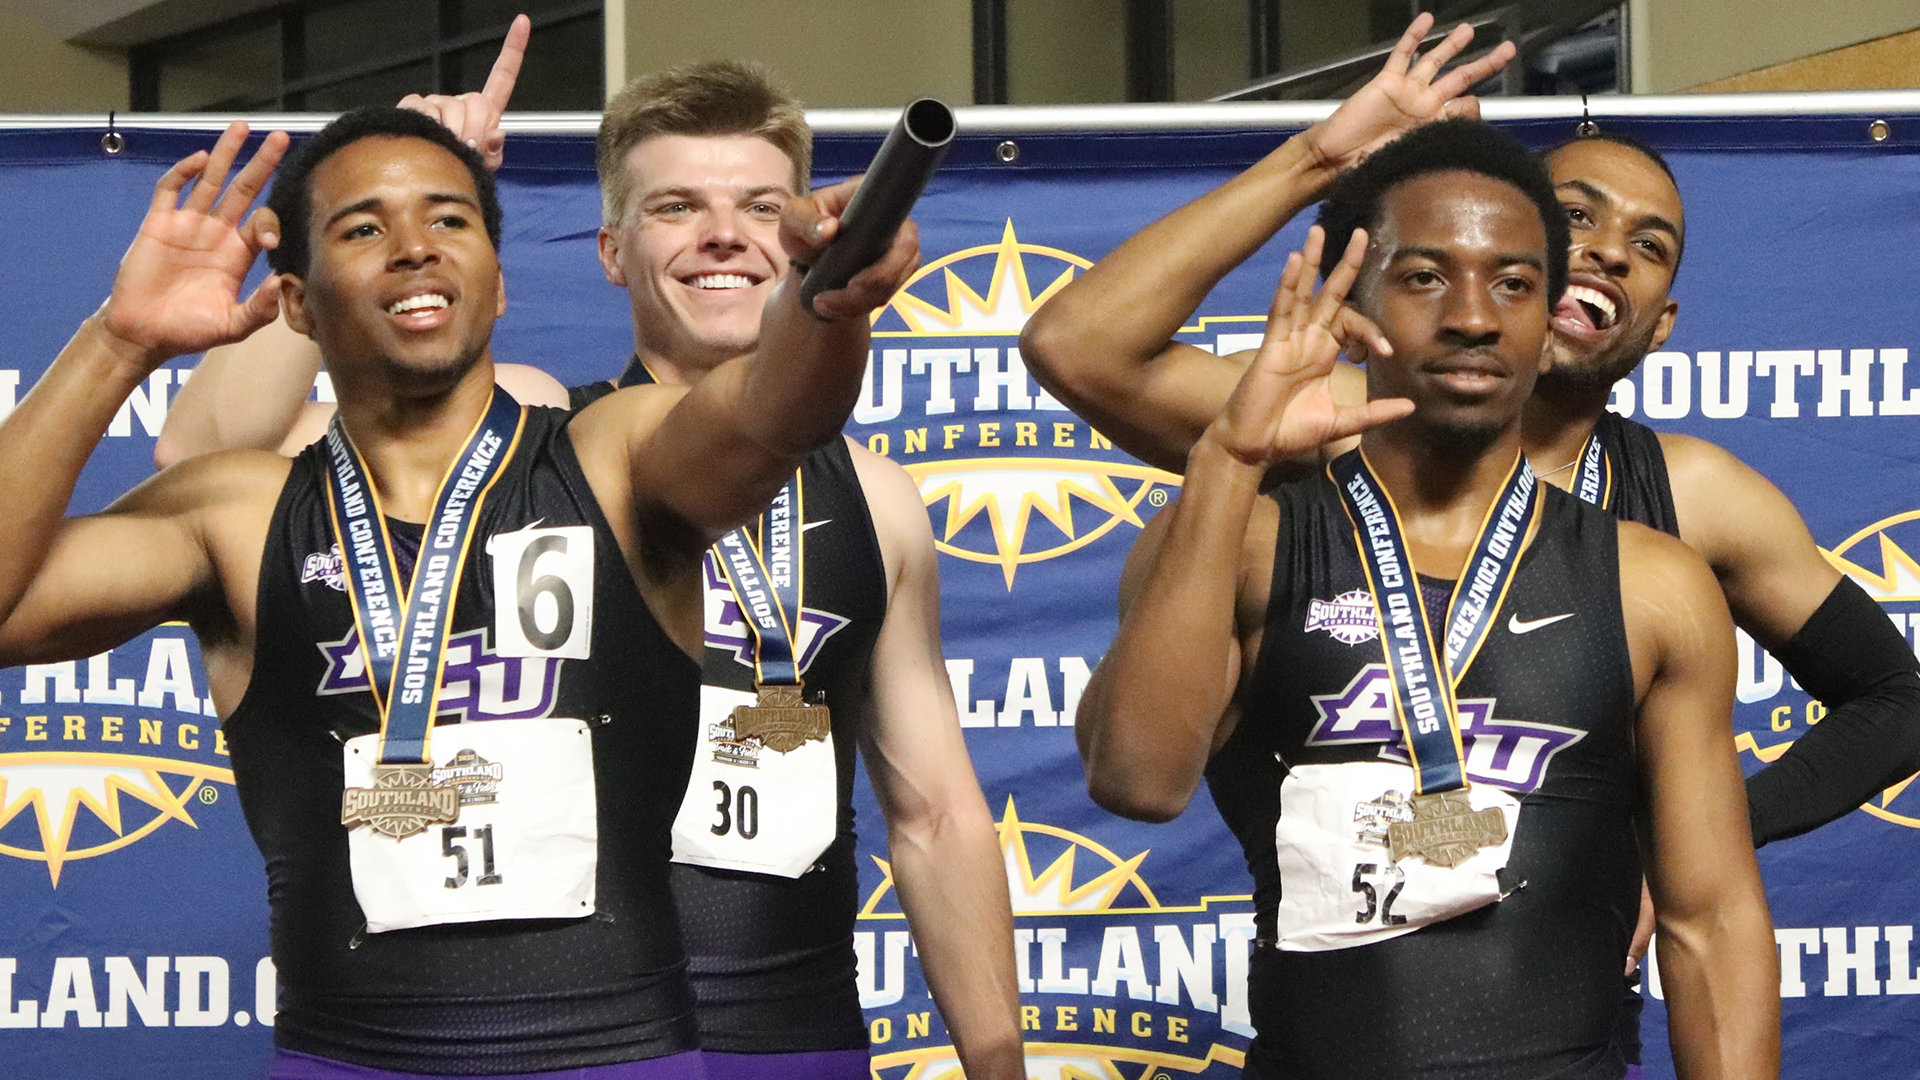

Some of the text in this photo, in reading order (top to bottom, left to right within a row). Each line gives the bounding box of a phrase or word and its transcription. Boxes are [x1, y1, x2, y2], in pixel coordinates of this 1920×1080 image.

[1580, 435, 1601, 505] ERENCE
[348, 518, 399, 658] CONFERENCE
[401, 428, 503, 704] SOUTHLAND CONFERENCE
[517, 535, 574, 650] 6
[1346, 472, 1440, 735] SOUTHLAND CONFERENCE
[1445, 555, 1501, 668] CONFEREN
[345, 789, 456, 818] SOUTHLAND
[432, 763, 501, 787] SOUTHLAND
[710, 780, 758, 840] 30
[442, 823, 502, 889] 51
[1352, 862, 1407, 926] 52
